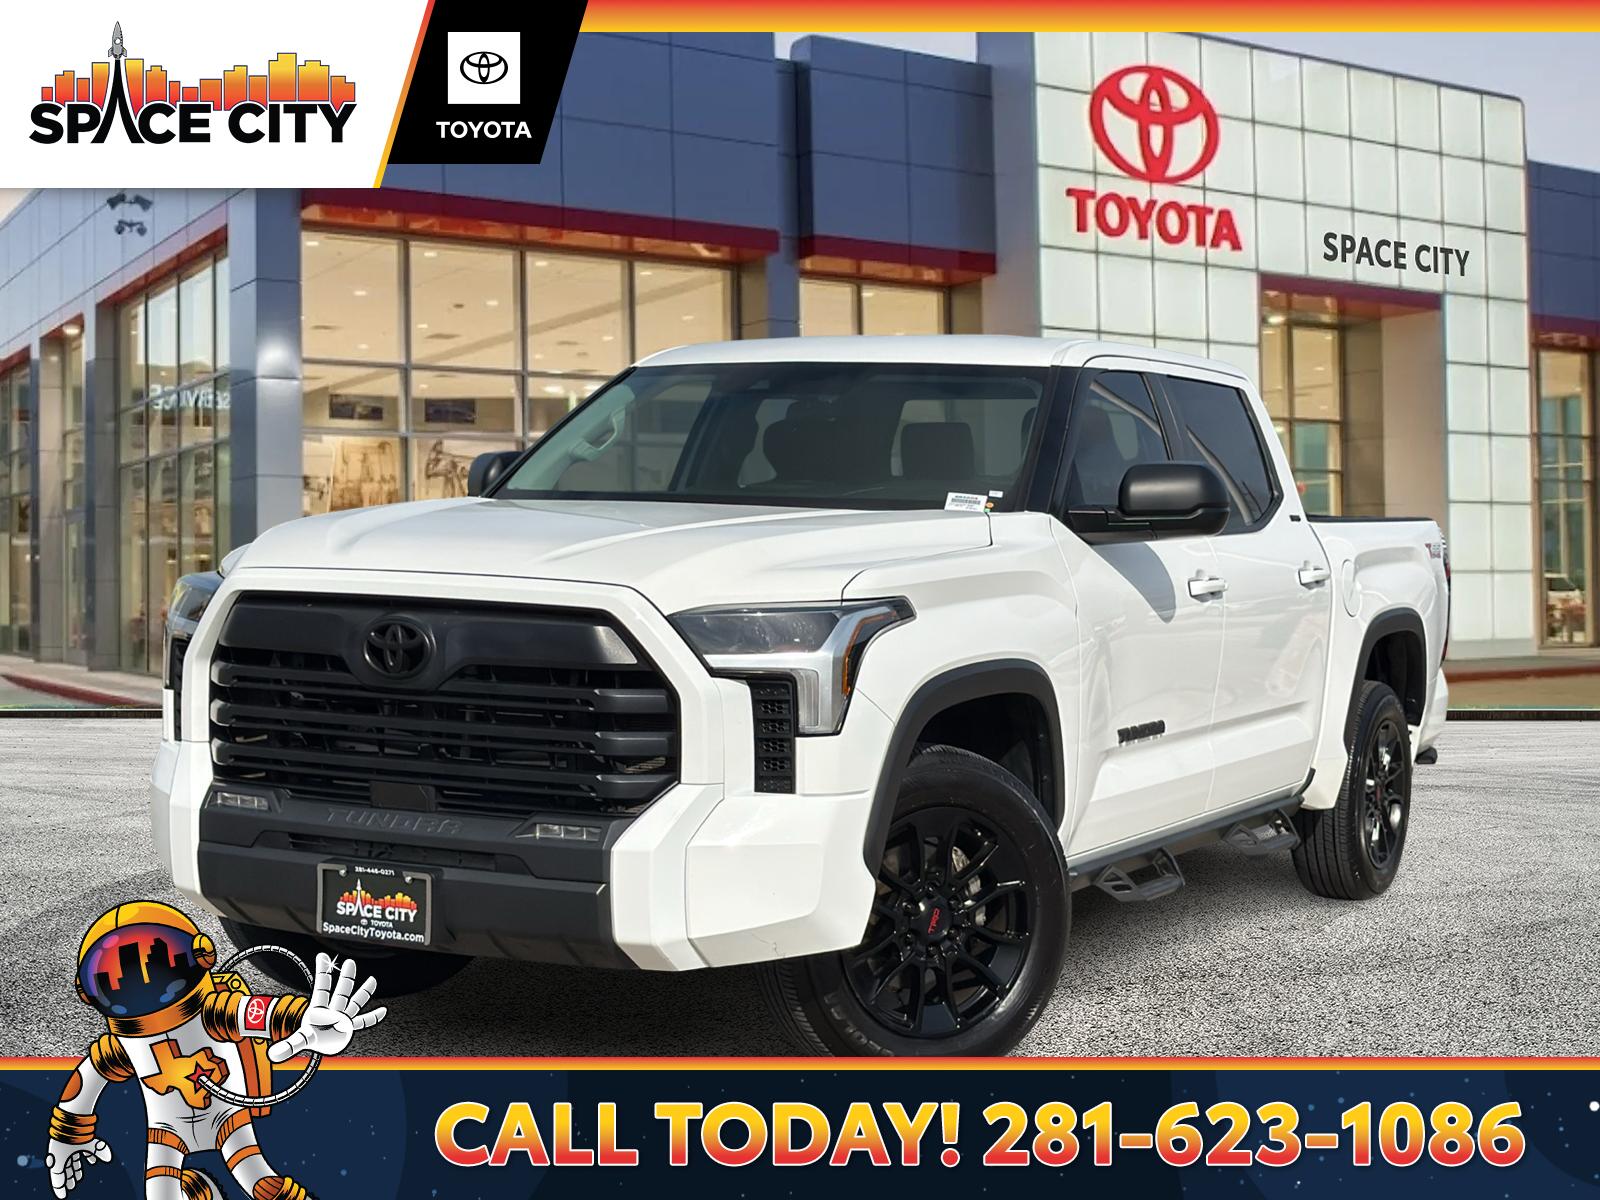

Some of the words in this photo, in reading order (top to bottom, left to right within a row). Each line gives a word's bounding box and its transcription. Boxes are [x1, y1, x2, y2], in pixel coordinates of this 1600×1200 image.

[1066, 187, 1242, 251] TOYOTA
[1323, 232, 1407, 270] SPACE
[1414, 244, 1470, 277] CITY
[370, 919, 394, 929] TOYOTA
[385, 905, 417, 922] CITY
[322, 921, 425, 943] SpaceCityToyota.com
